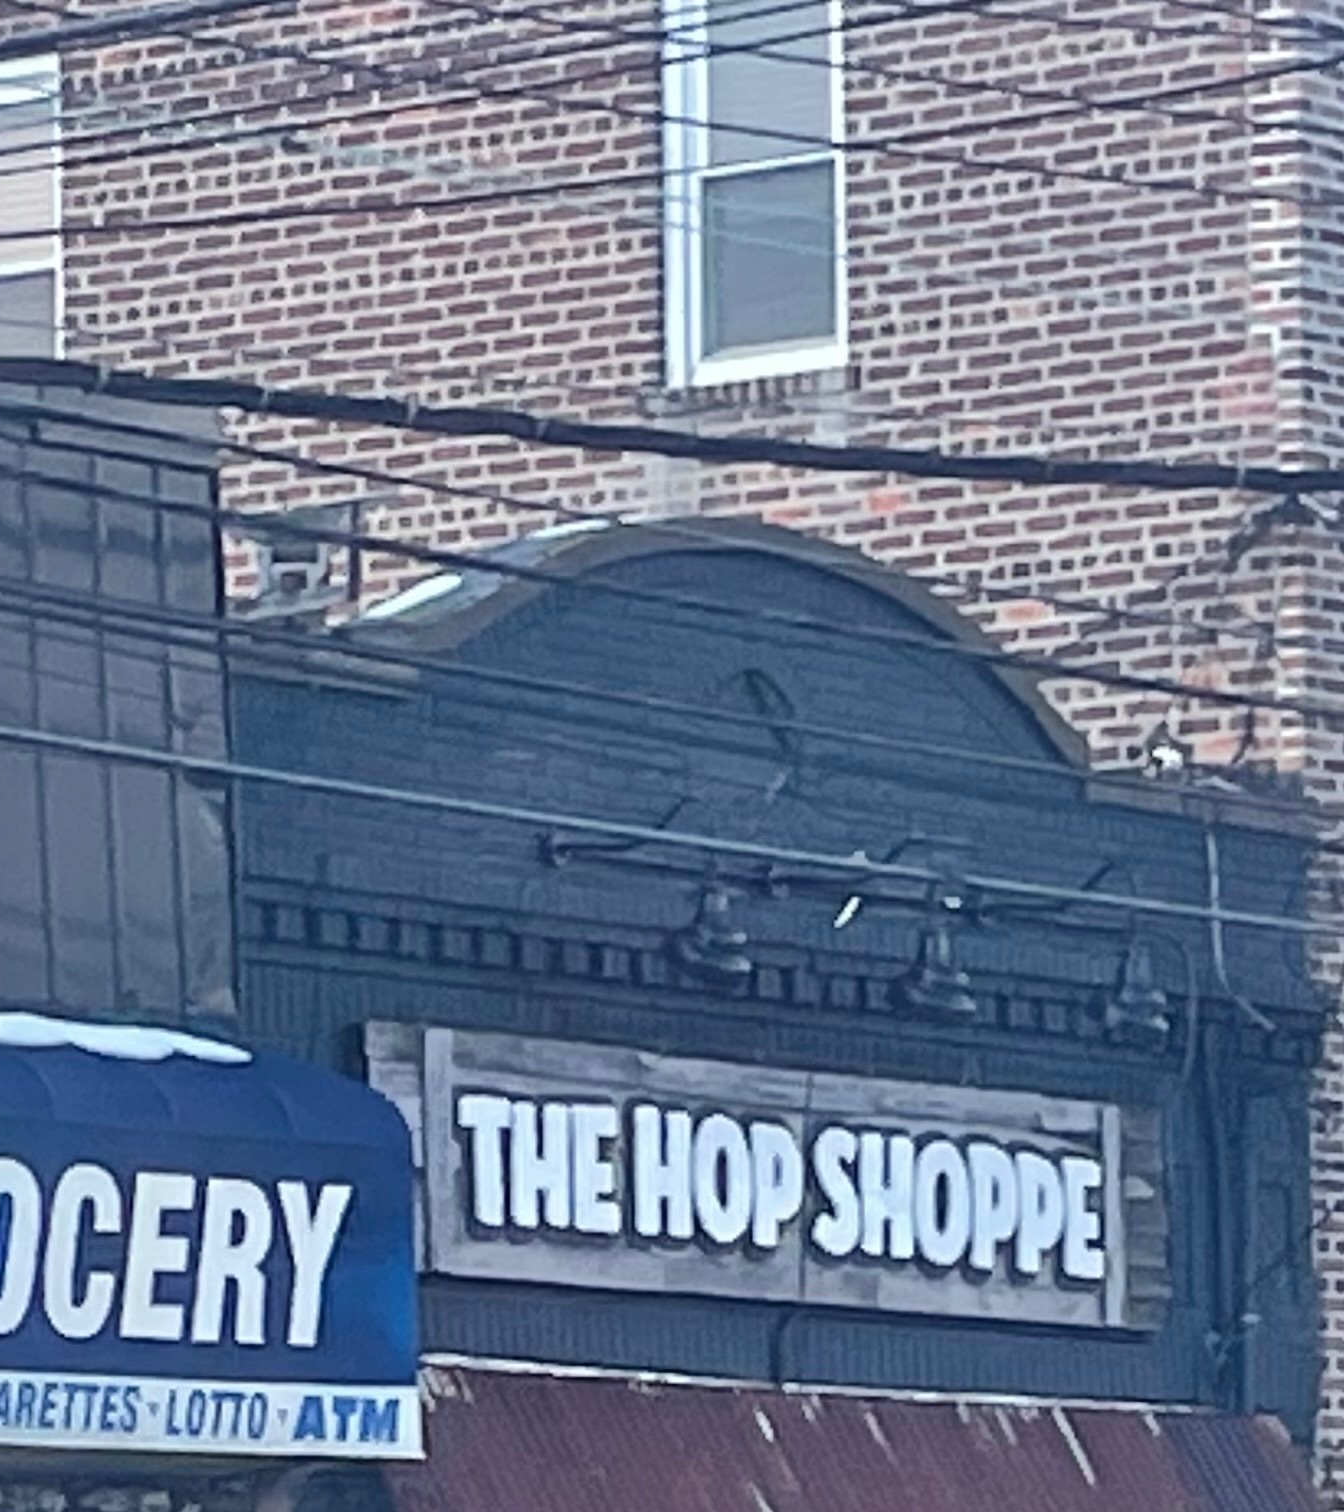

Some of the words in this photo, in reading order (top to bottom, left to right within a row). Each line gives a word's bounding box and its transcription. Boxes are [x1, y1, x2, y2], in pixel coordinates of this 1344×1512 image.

[458, 1094, 621, 1235] THE
[633, 1104, 804, 1247] HOP
[811, 1125, 1105, 1279] SHOPPE
[165, 1387, 268, 1442] LOTTO
[292, 1394, 400, 1444] ATM
